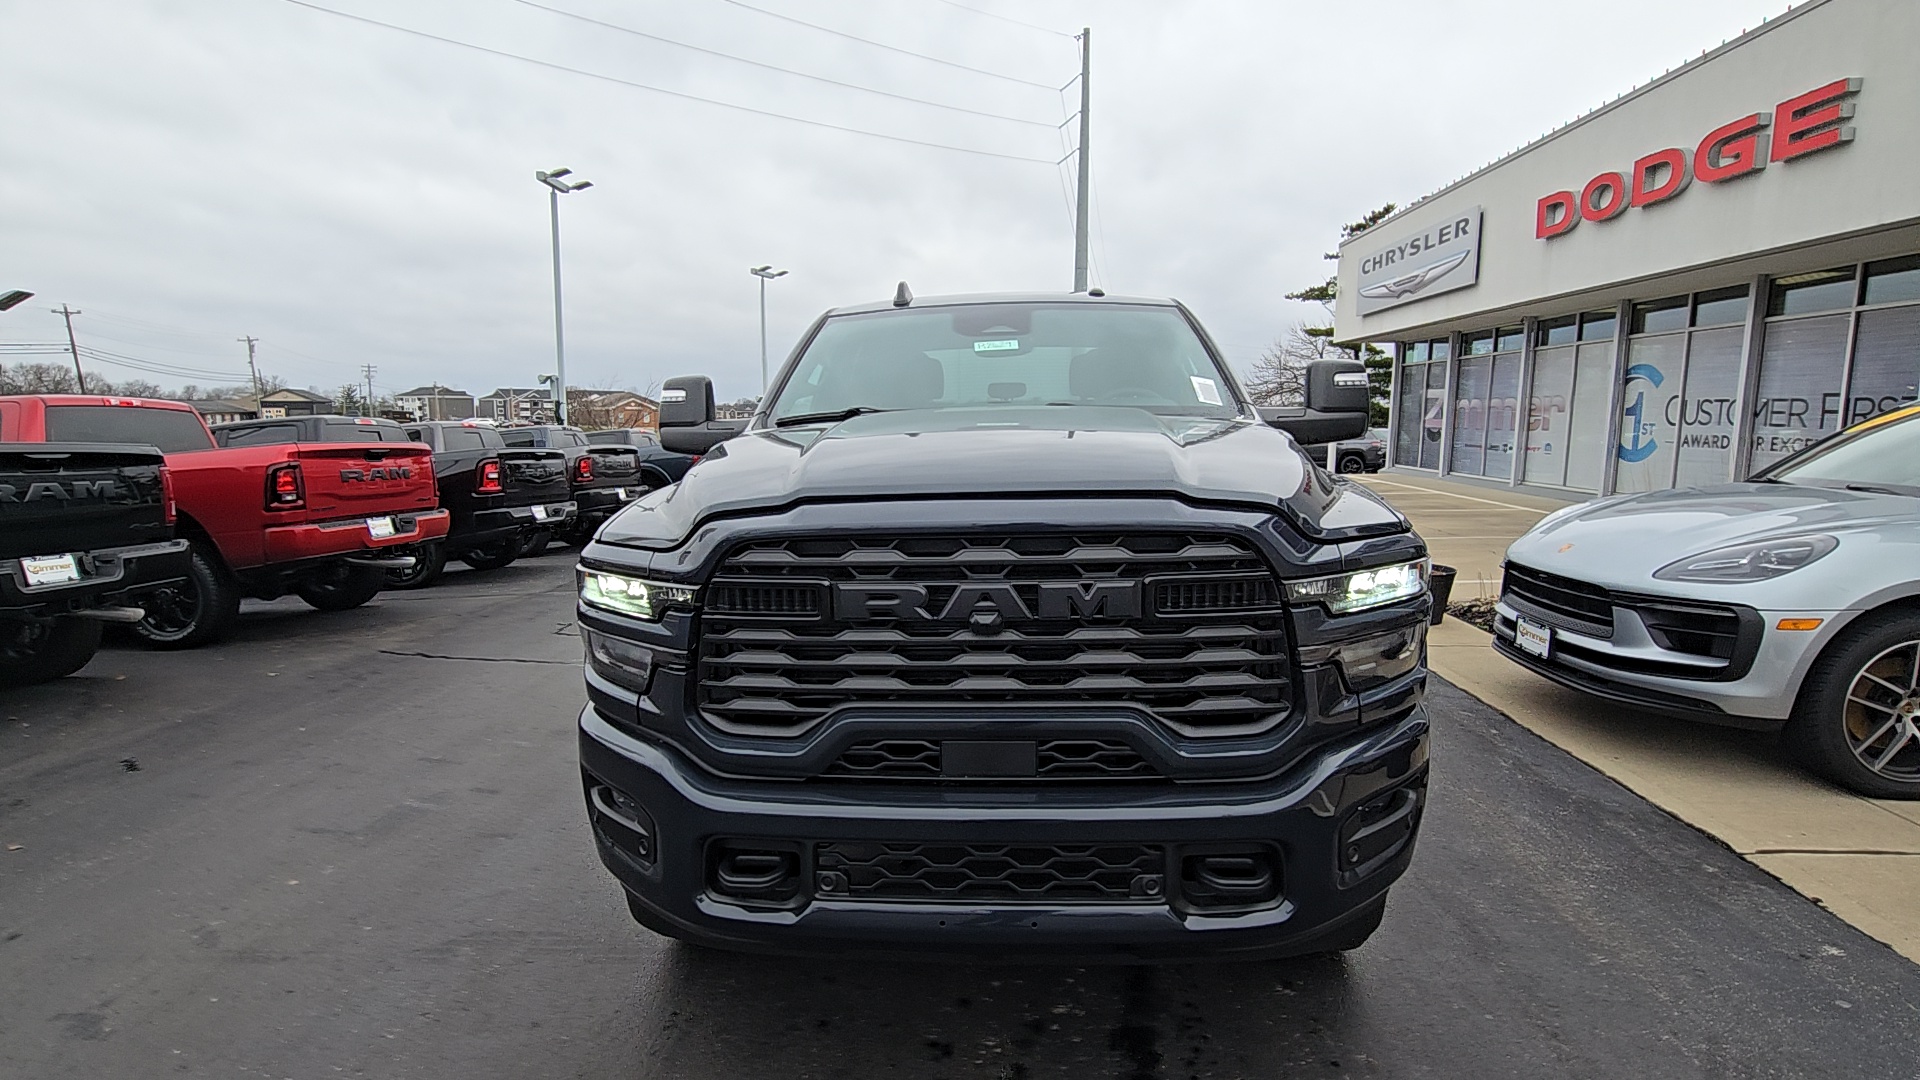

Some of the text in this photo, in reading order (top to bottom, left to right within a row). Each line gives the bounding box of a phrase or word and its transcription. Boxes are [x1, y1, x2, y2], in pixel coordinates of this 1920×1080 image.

[1536, 77, 1862, 240] DODGE
[1361, 217, 1470, 275] CHRYSLER
[1420, 388, 1566, 432] Zmmer
[1681, 434, 1731, 450] AWARD
[340, 467, 411, 483] RAM
[835, 582, 1143, 621] RAM
